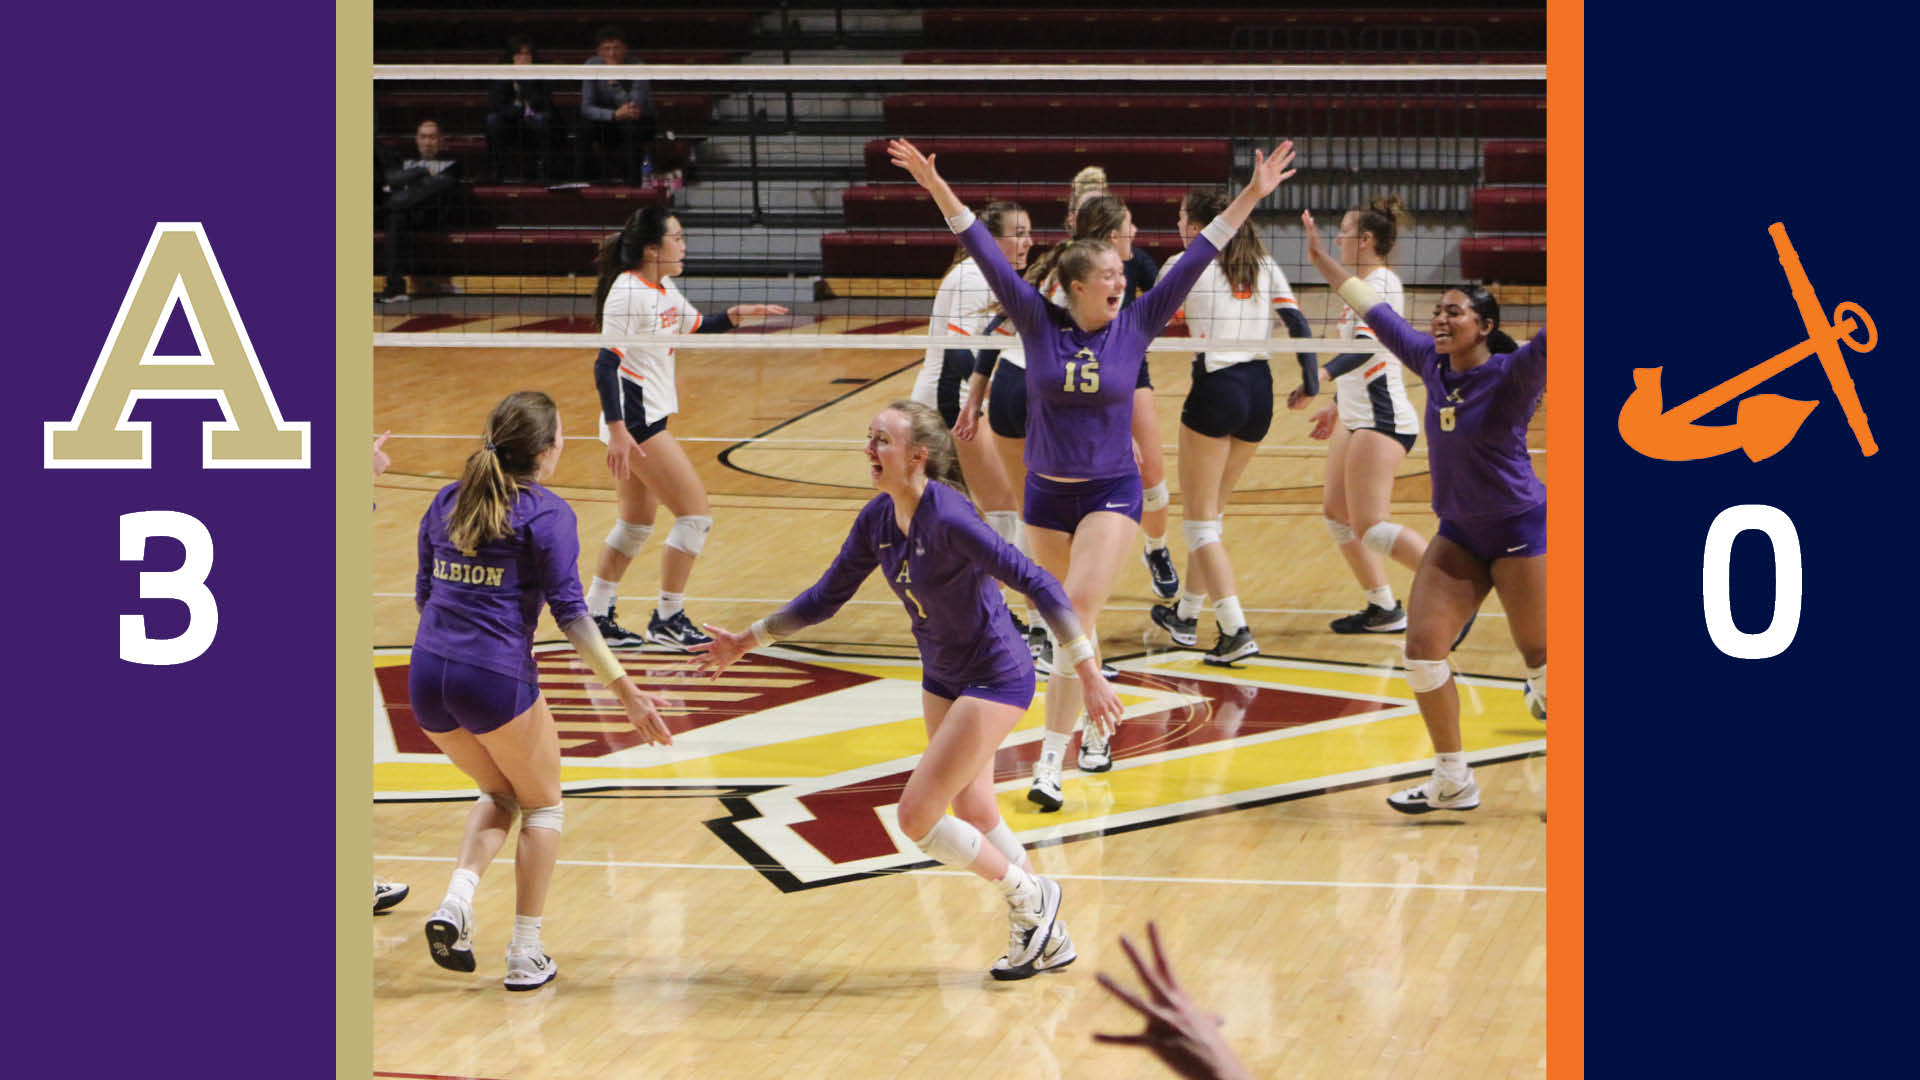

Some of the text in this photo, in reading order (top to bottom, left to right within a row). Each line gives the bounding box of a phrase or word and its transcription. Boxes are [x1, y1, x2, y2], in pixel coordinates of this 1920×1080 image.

[1063, 362, 1100, 393] 15
[432, 558, 505, 587] ALBION
[895, 559, 912, 584] A
